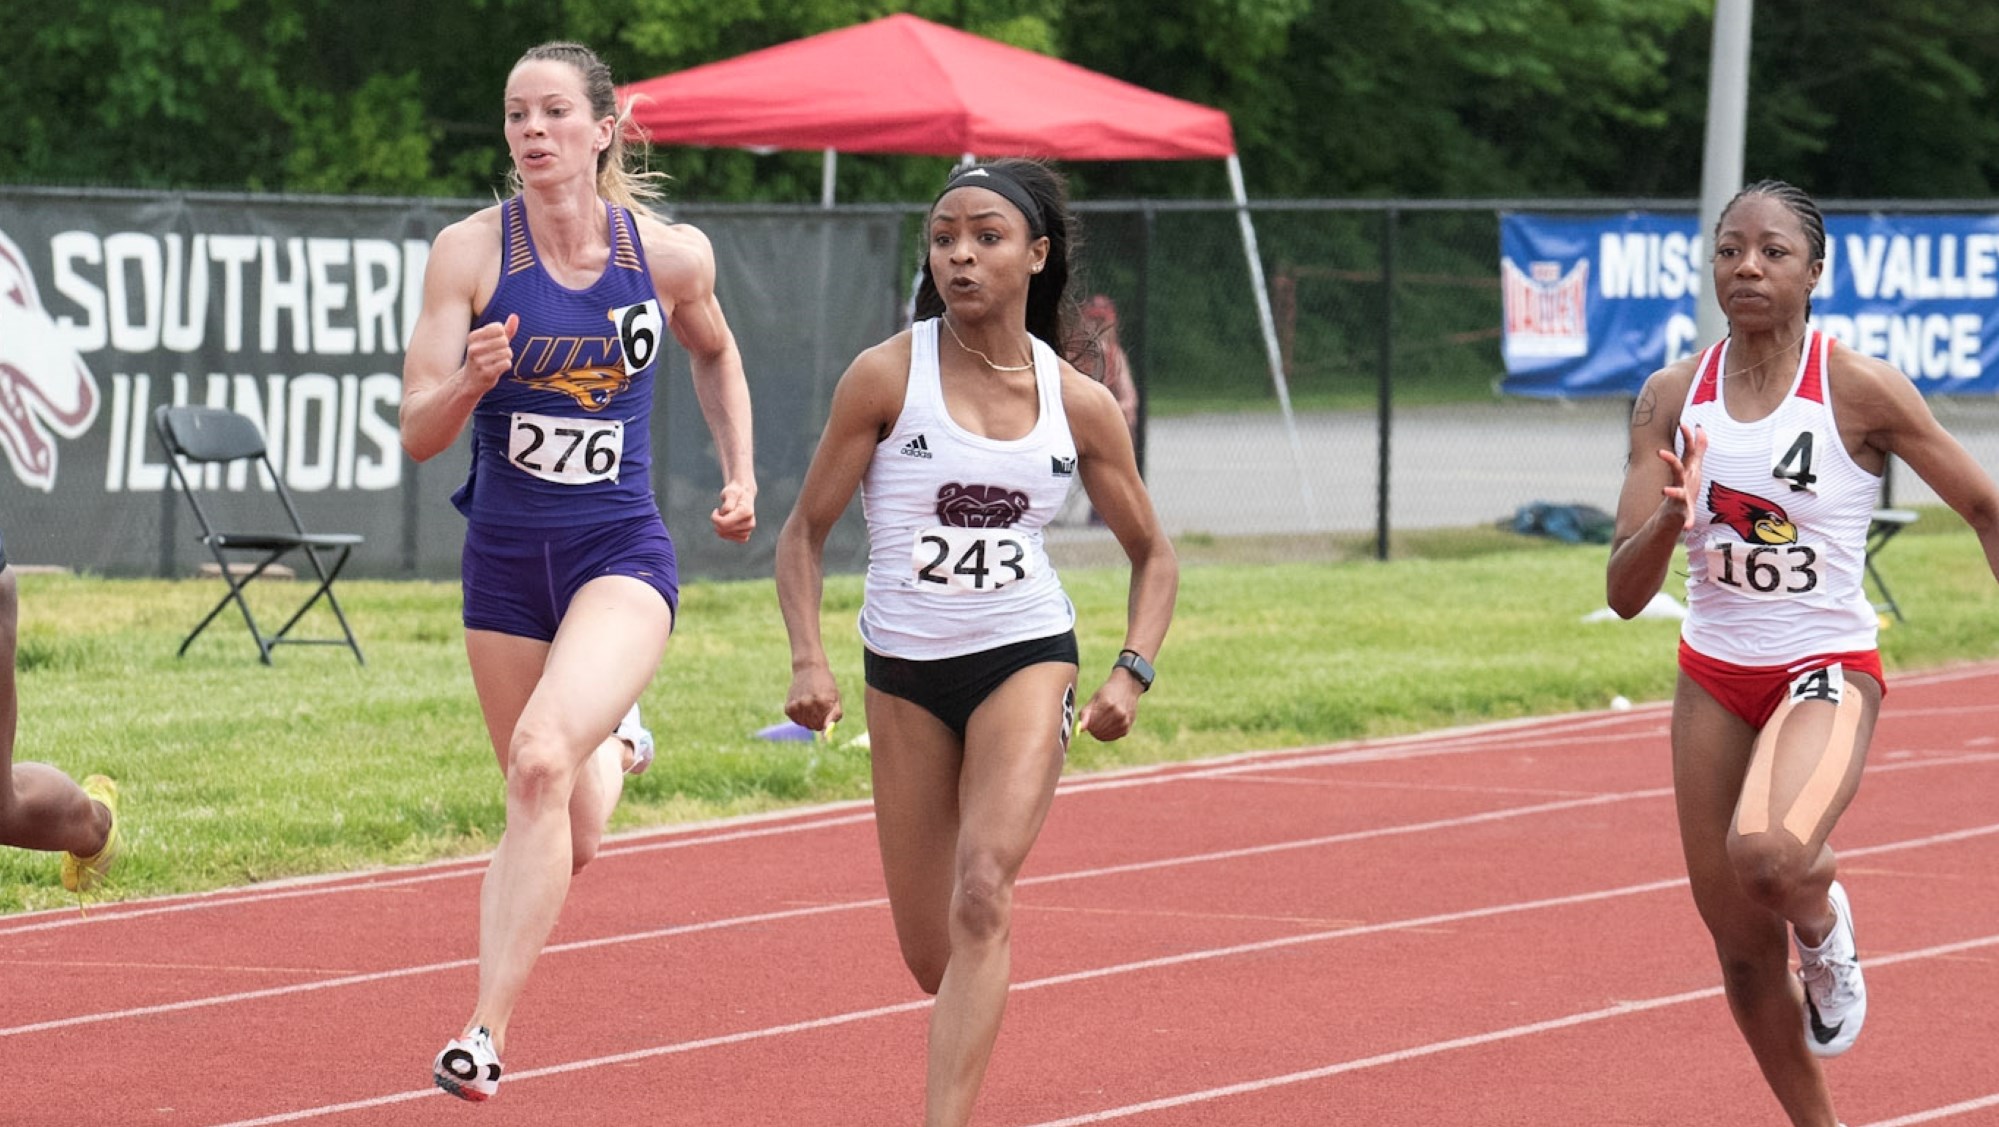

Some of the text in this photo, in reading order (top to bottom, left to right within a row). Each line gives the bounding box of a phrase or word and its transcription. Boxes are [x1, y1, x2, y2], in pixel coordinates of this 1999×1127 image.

[1845, 233, 1999, 299] VALLE
[513, 336, 626, 379] UN
[621, 303, 654, 370] 6
[514, 422, 616, 476] 276
[900, 447, 932, 459] adidas
[1772, 431, 1817, 492] 4
[918, 535, 1026, 590] 243
[1714, 541, 1818, 594] 163
[1792, 668, 1839, 704] 4
